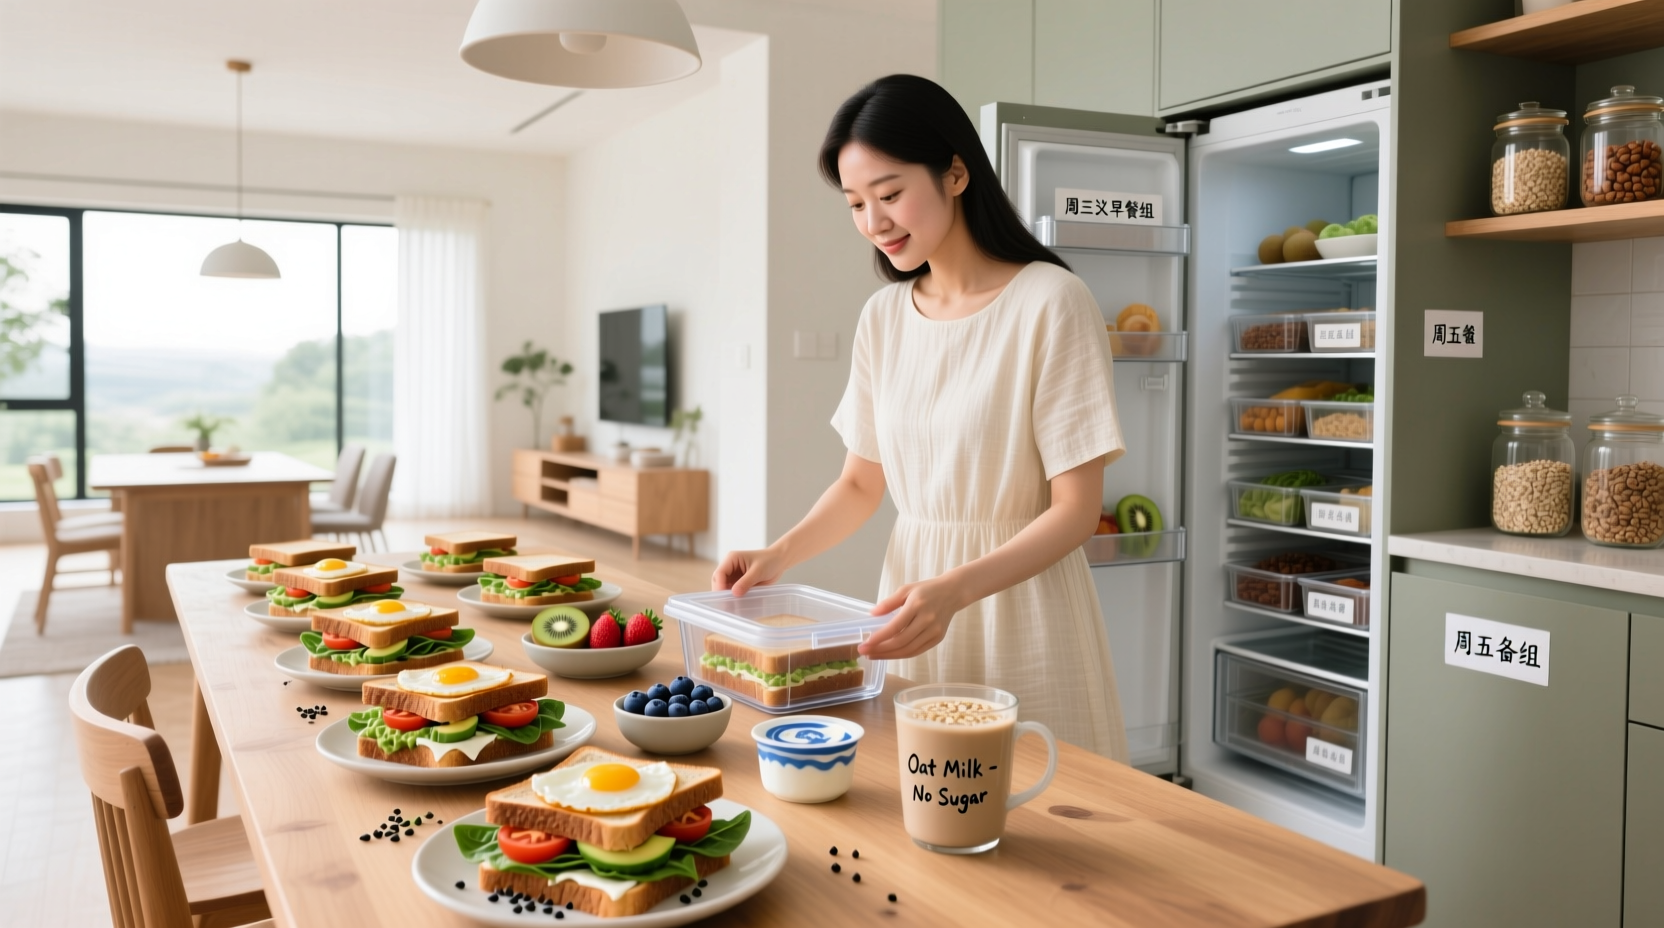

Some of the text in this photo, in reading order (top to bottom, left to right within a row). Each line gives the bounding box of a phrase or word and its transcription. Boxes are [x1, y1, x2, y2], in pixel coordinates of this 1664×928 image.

[908, 753, 937, 777] Oat
[943, 757, 983, 779] Milk
[913, 784, 988, 814] No Sugar
